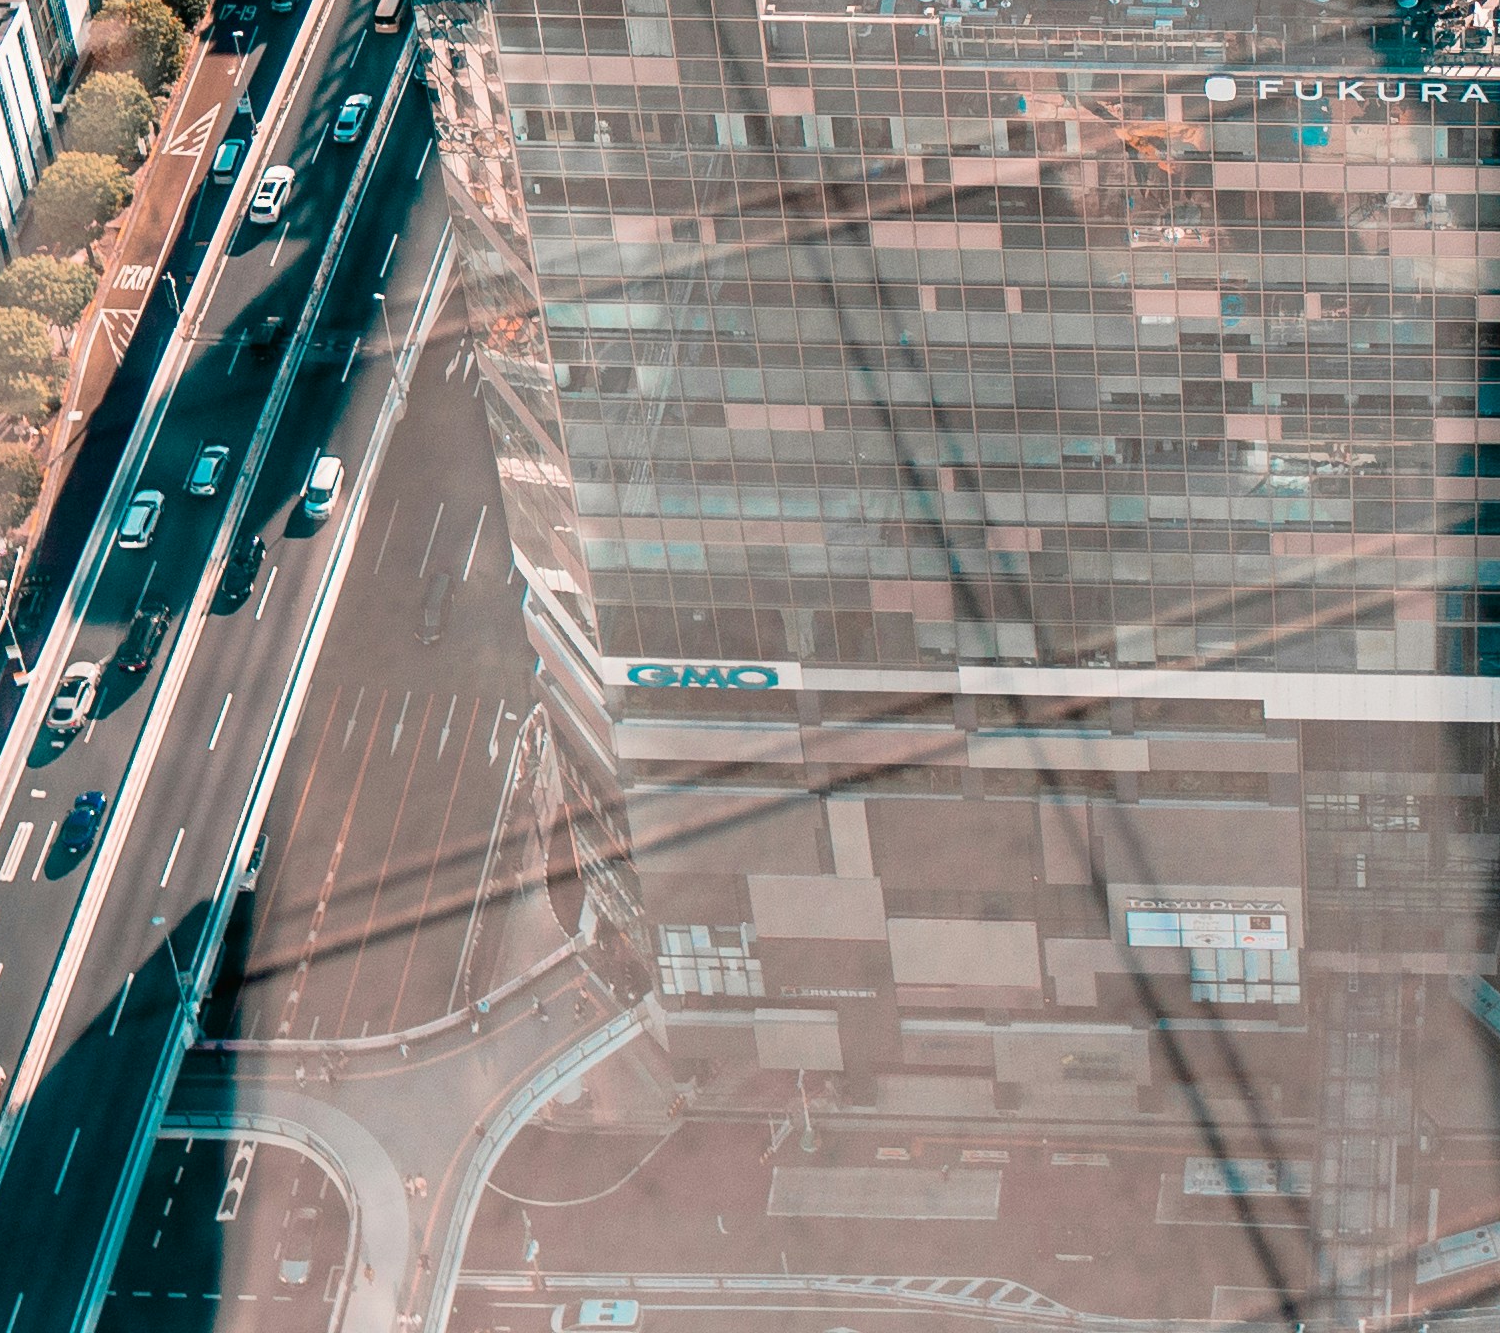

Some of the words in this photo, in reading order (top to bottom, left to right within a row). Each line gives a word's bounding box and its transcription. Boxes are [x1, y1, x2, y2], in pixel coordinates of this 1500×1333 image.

[627, 666, 779, 690] GMO
[1128, 898, 1202, 910] TOKYU
[1209, 898, 1286, 911] PLAZA
